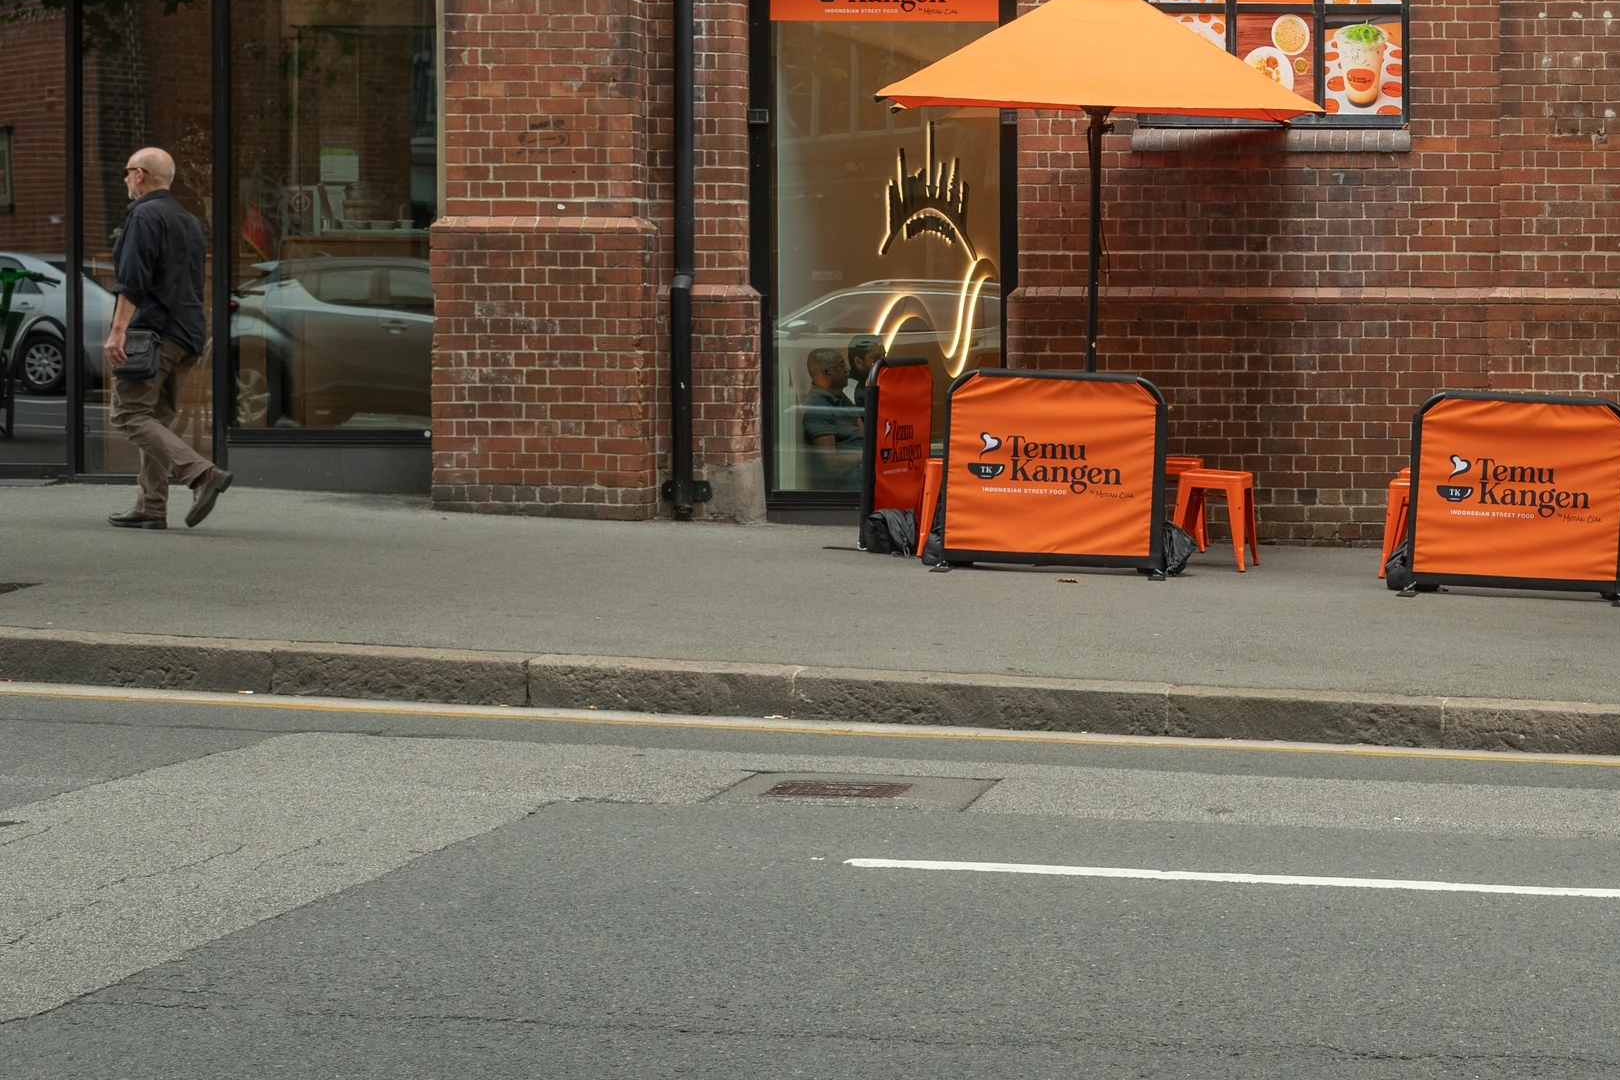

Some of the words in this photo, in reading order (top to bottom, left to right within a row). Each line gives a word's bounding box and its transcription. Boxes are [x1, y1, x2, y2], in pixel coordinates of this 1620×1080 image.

[892, 420, 914, 441] Temu
[891, 441, 923, 470] Kangen
[1006, 436, 1087, 461] Temu
[980, 466, 993, 474] TK
[1010, 459, 1122, 494] Kangen
[1475, 458, 1555, 484] Temu
[1449, 488, 1461, 496] TK
[1478, 481, 1590, 518] Kangen
